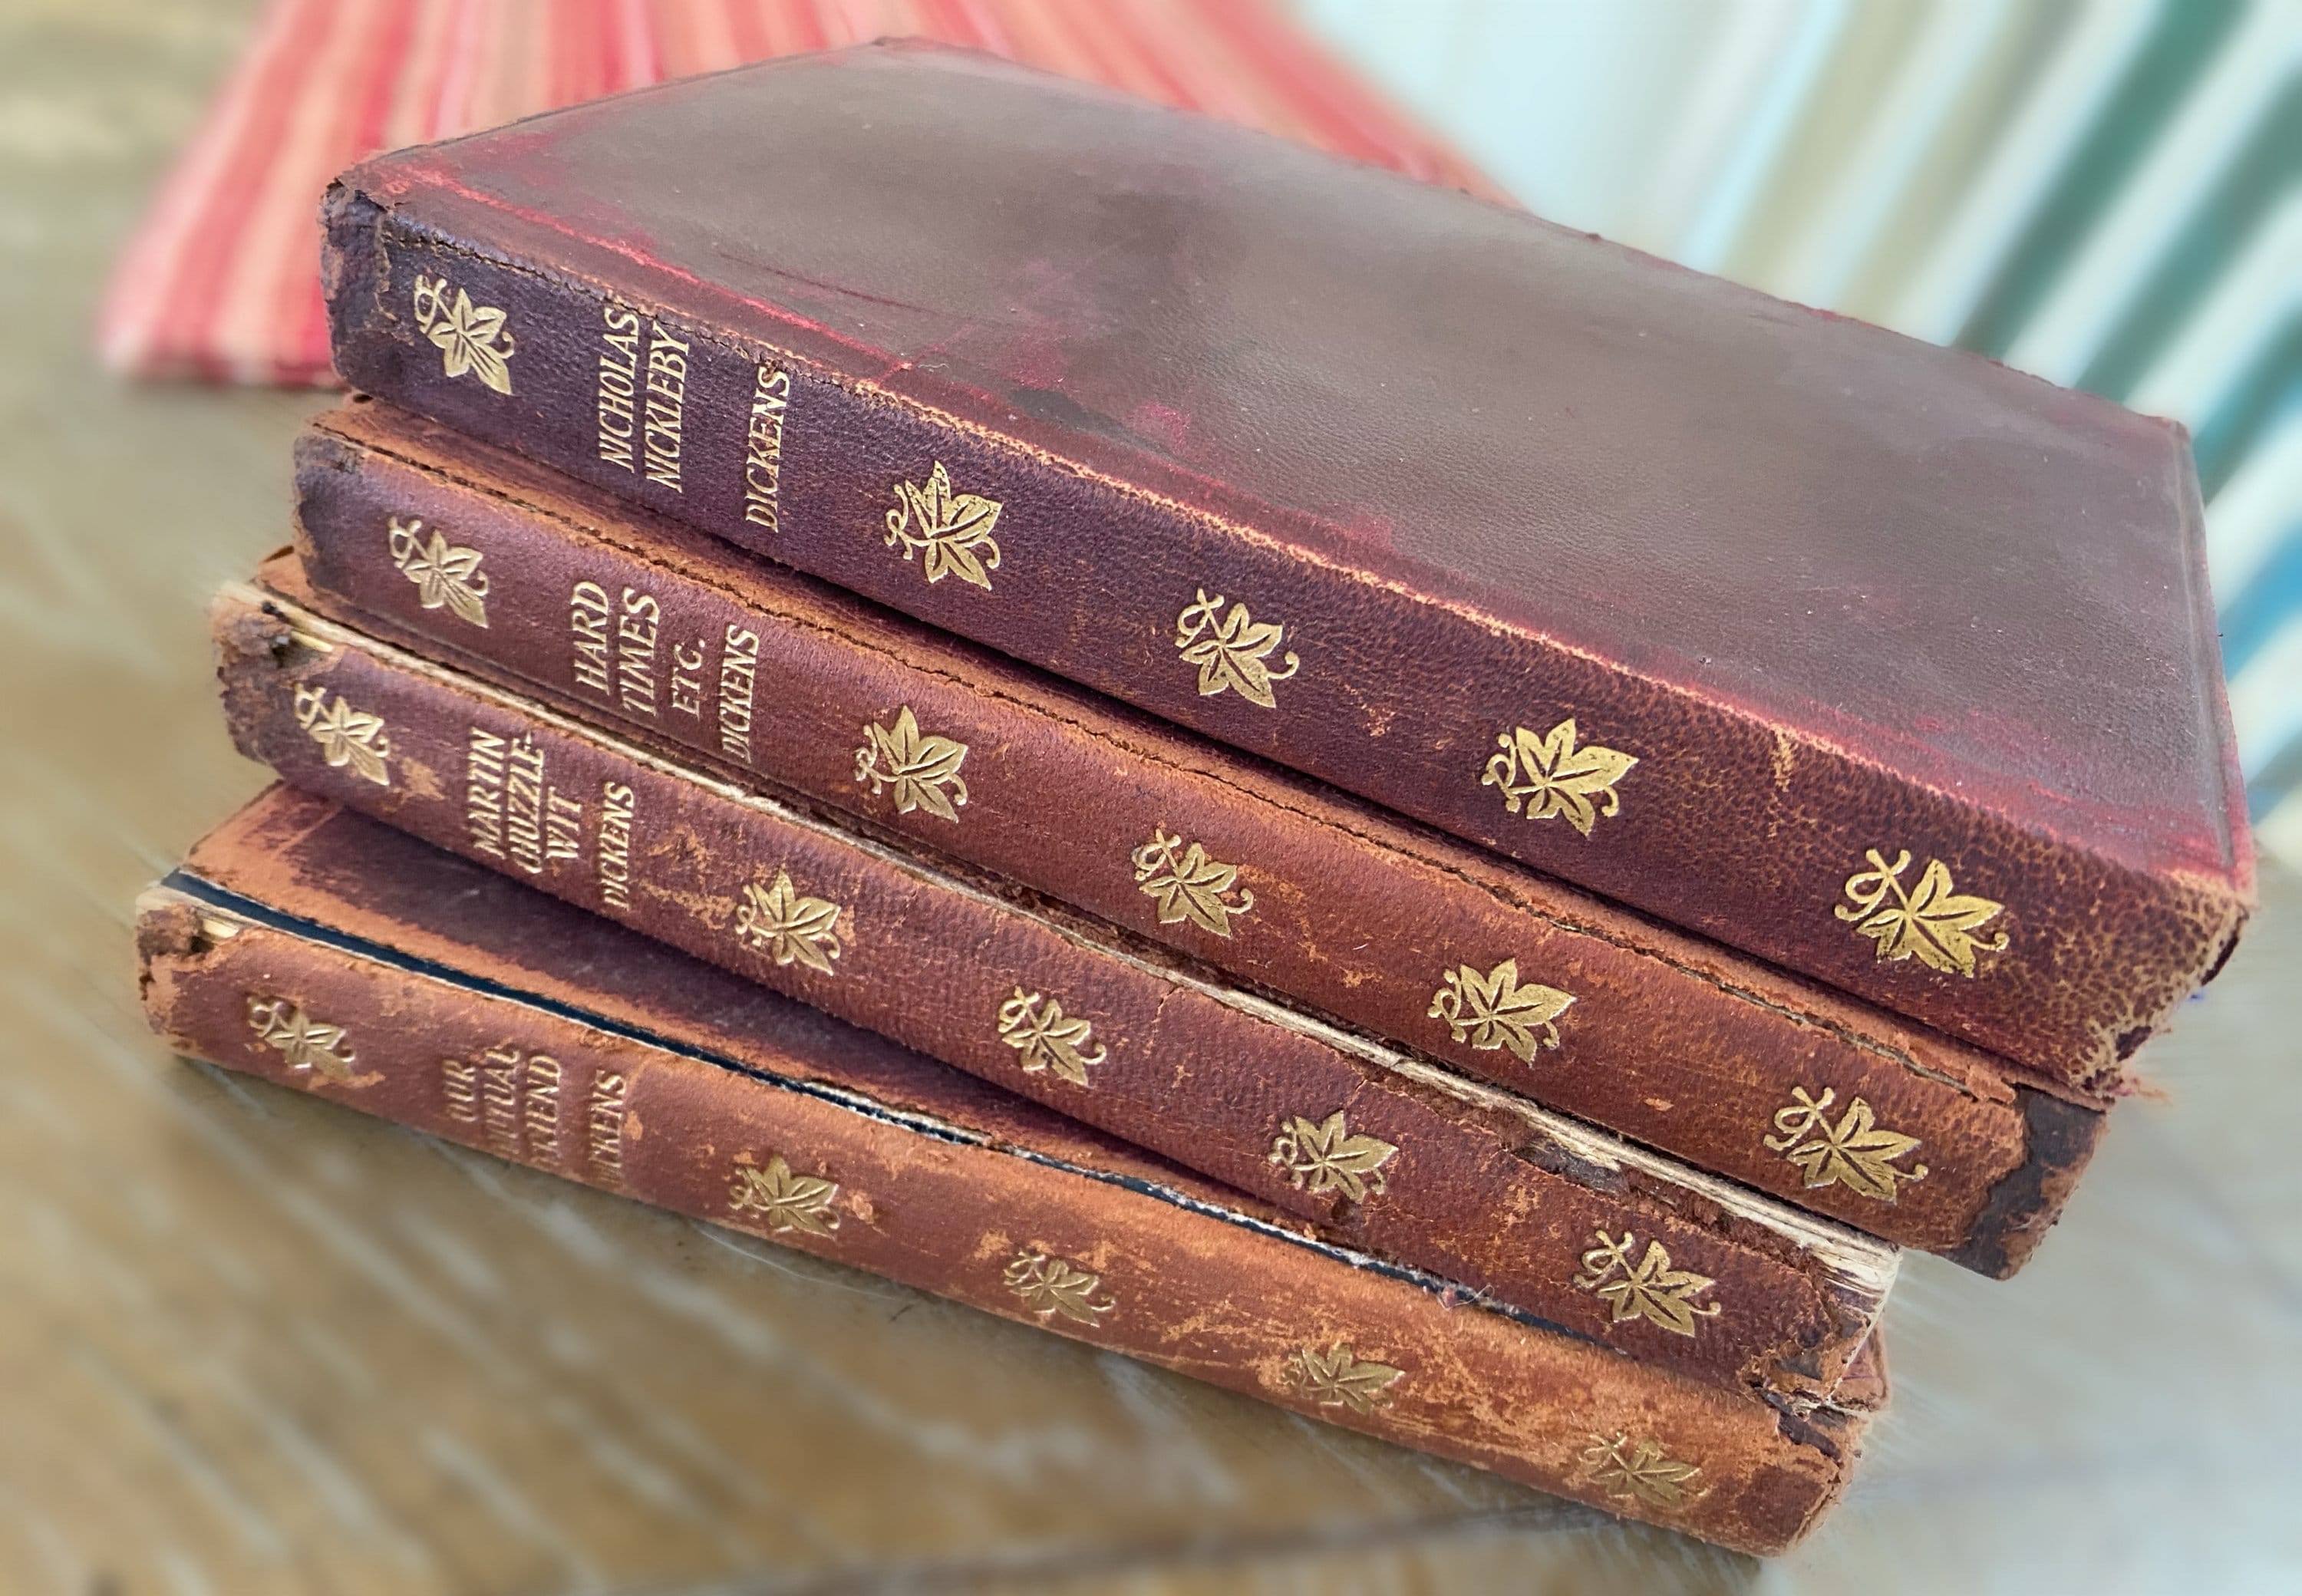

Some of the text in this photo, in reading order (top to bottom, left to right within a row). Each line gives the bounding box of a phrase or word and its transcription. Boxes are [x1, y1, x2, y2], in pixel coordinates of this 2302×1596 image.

[599, 306, 639, 473] NICHOLAS
[644, 320, 689, 493] NICKLEBY
[744, 366, 790, 534] DICKENS
[571, 581, 608, 696] HARD
[618, 586, 660, 717] TIMES
[671, 638, 705, 721] ETC.
[718, 624, 760, 764] DICKENS
[467, 726, 504, 860] MARTIN
[546, 785, 582, 859] WIT
[599, 781, 635, 912] DICKENS
[443, 1059, 477, 1123] OUR
[588, 1069, 628, 1186] CKENS
